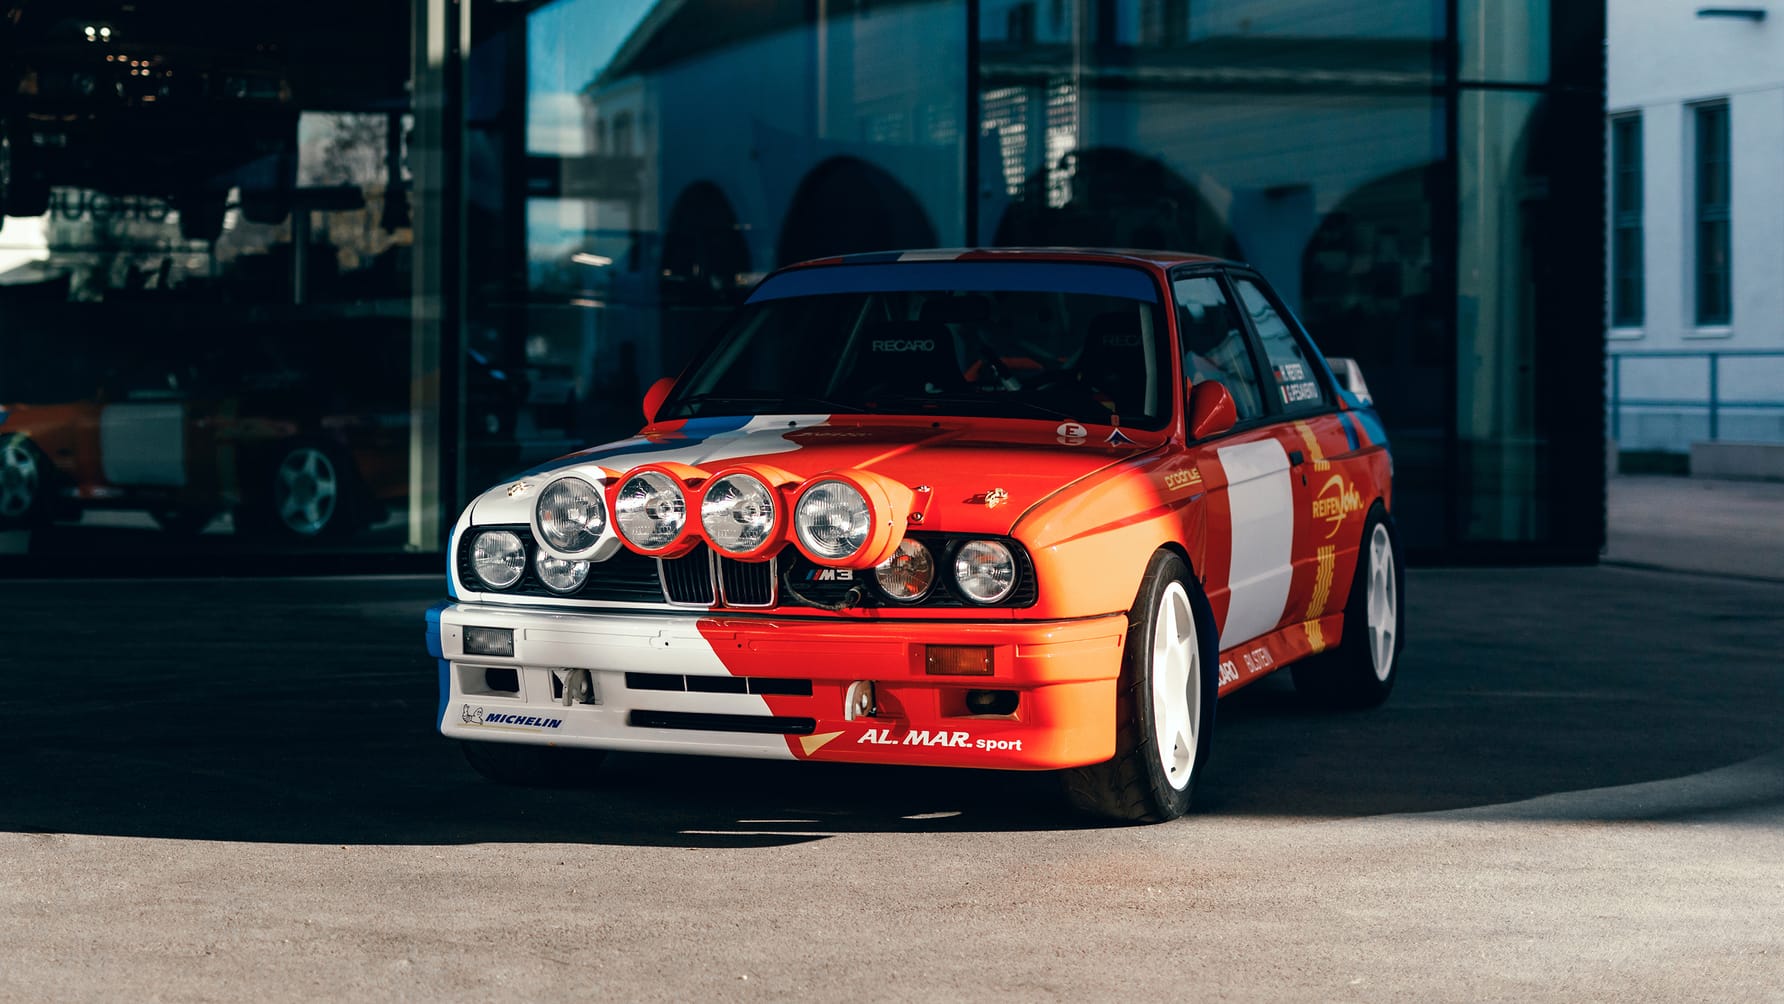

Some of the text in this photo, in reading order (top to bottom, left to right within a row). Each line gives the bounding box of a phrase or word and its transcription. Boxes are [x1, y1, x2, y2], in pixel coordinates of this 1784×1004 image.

[872, 339, 935, 352] RECARO
[1065, 425, 1079, 436] E
[1312, 496, 1341, 519] REIFEN
[818, 569, 853, 581] M3
[485, 713, 562, 728] MICHELIN
[857, 729, 1022, 752] AL. MAR. sport
